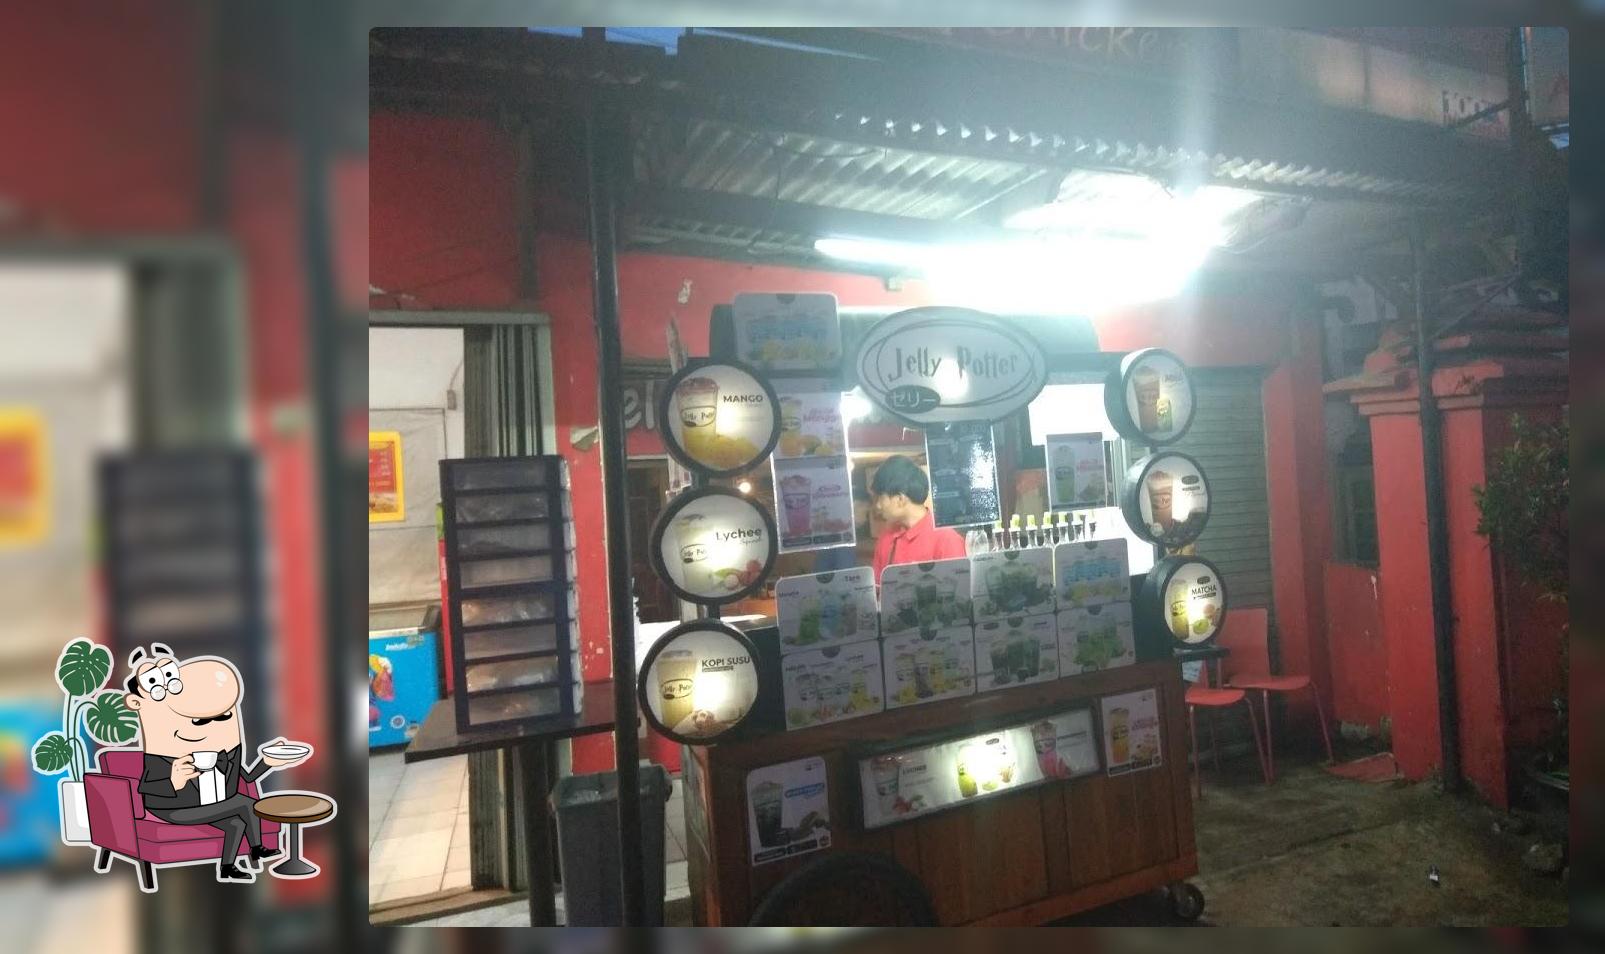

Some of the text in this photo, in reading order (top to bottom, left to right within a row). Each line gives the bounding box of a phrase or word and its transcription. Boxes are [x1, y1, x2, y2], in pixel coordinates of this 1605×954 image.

[888, 345, 1018, 382] Jelly Potter
[722, 394, 763, 403] MANGO
[715, 528, 761, 541] Lychee
[1191, 584, 1217, 596] MATCHA
[701, 656, 751, 668] KOPI SUSU
